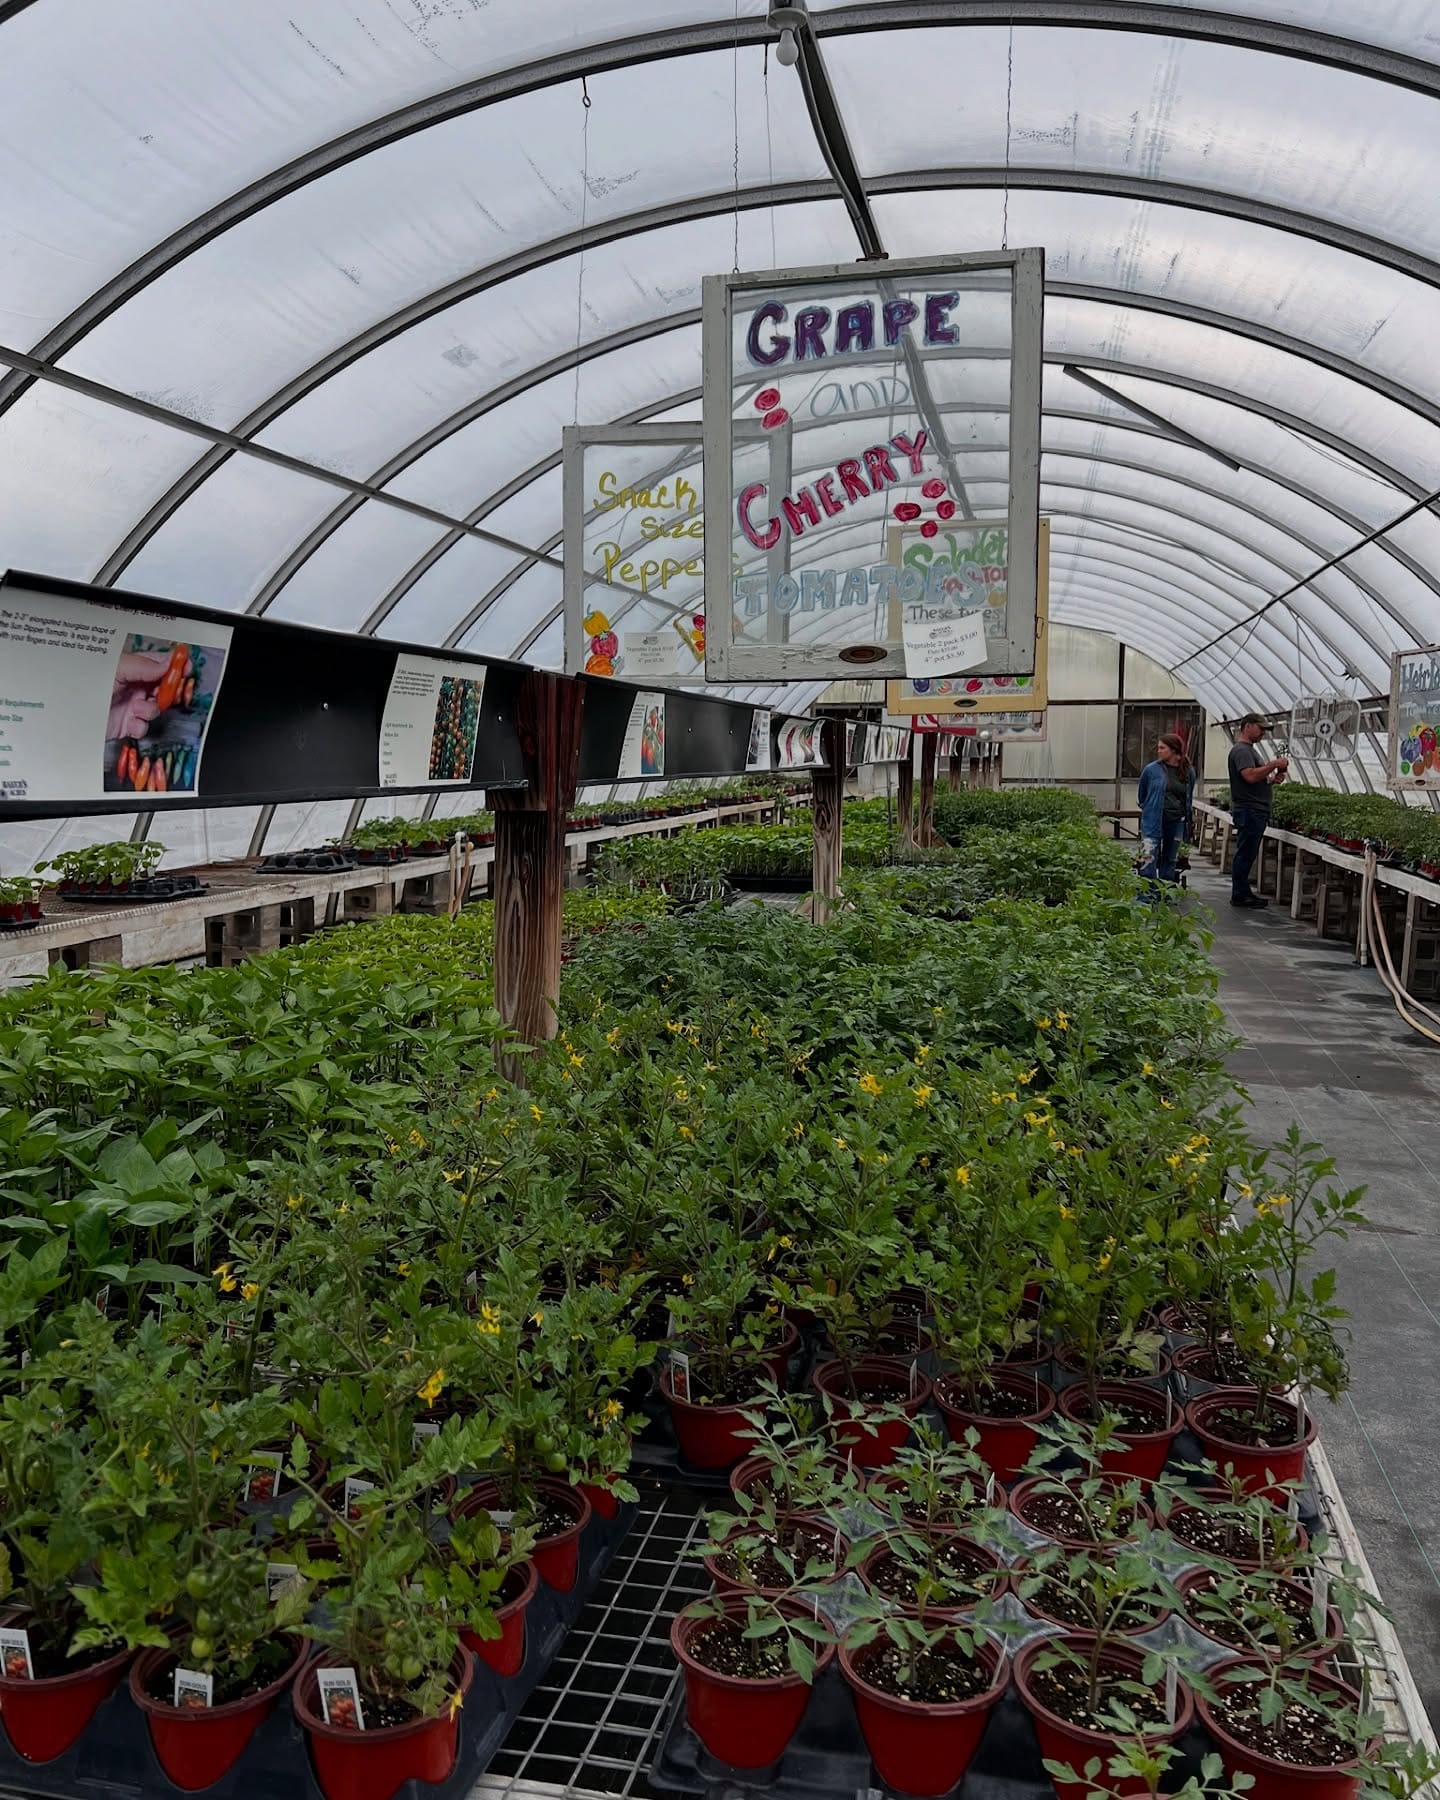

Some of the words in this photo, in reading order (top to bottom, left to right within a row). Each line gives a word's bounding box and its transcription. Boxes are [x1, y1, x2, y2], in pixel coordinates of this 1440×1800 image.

[745, 290, 960, 367] GRAPE
[593, 471, 697, 517] Snack
[737, 429, 930, 551] CHERRY
[592, 541, 744, 593] Peppes
[734, 564, 986, 616] TOMATOES
[907, 604, 953, 621] These
[958, 606, 1001, 620] tyes
[1402, 658, 1440, 693] Heirlo
